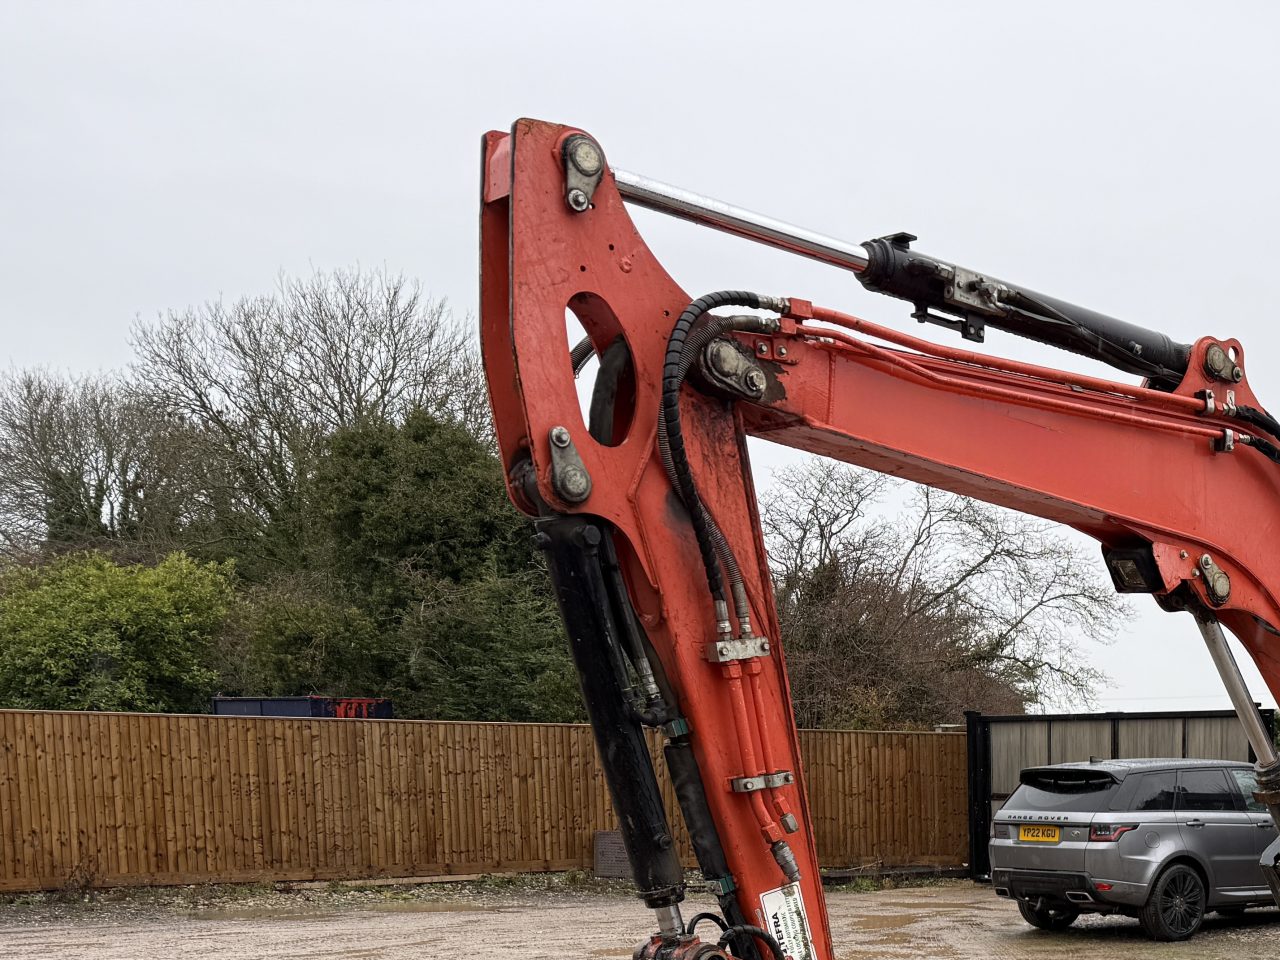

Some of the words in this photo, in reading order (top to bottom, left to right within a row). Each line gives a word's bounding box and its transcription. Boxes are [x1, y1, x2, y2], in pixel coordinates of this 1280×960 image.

[1023, 827, 1040, 838] YP22
[1041, 828, 1056, 838] KGU
[771, 912, 786, 947] TEFRA
